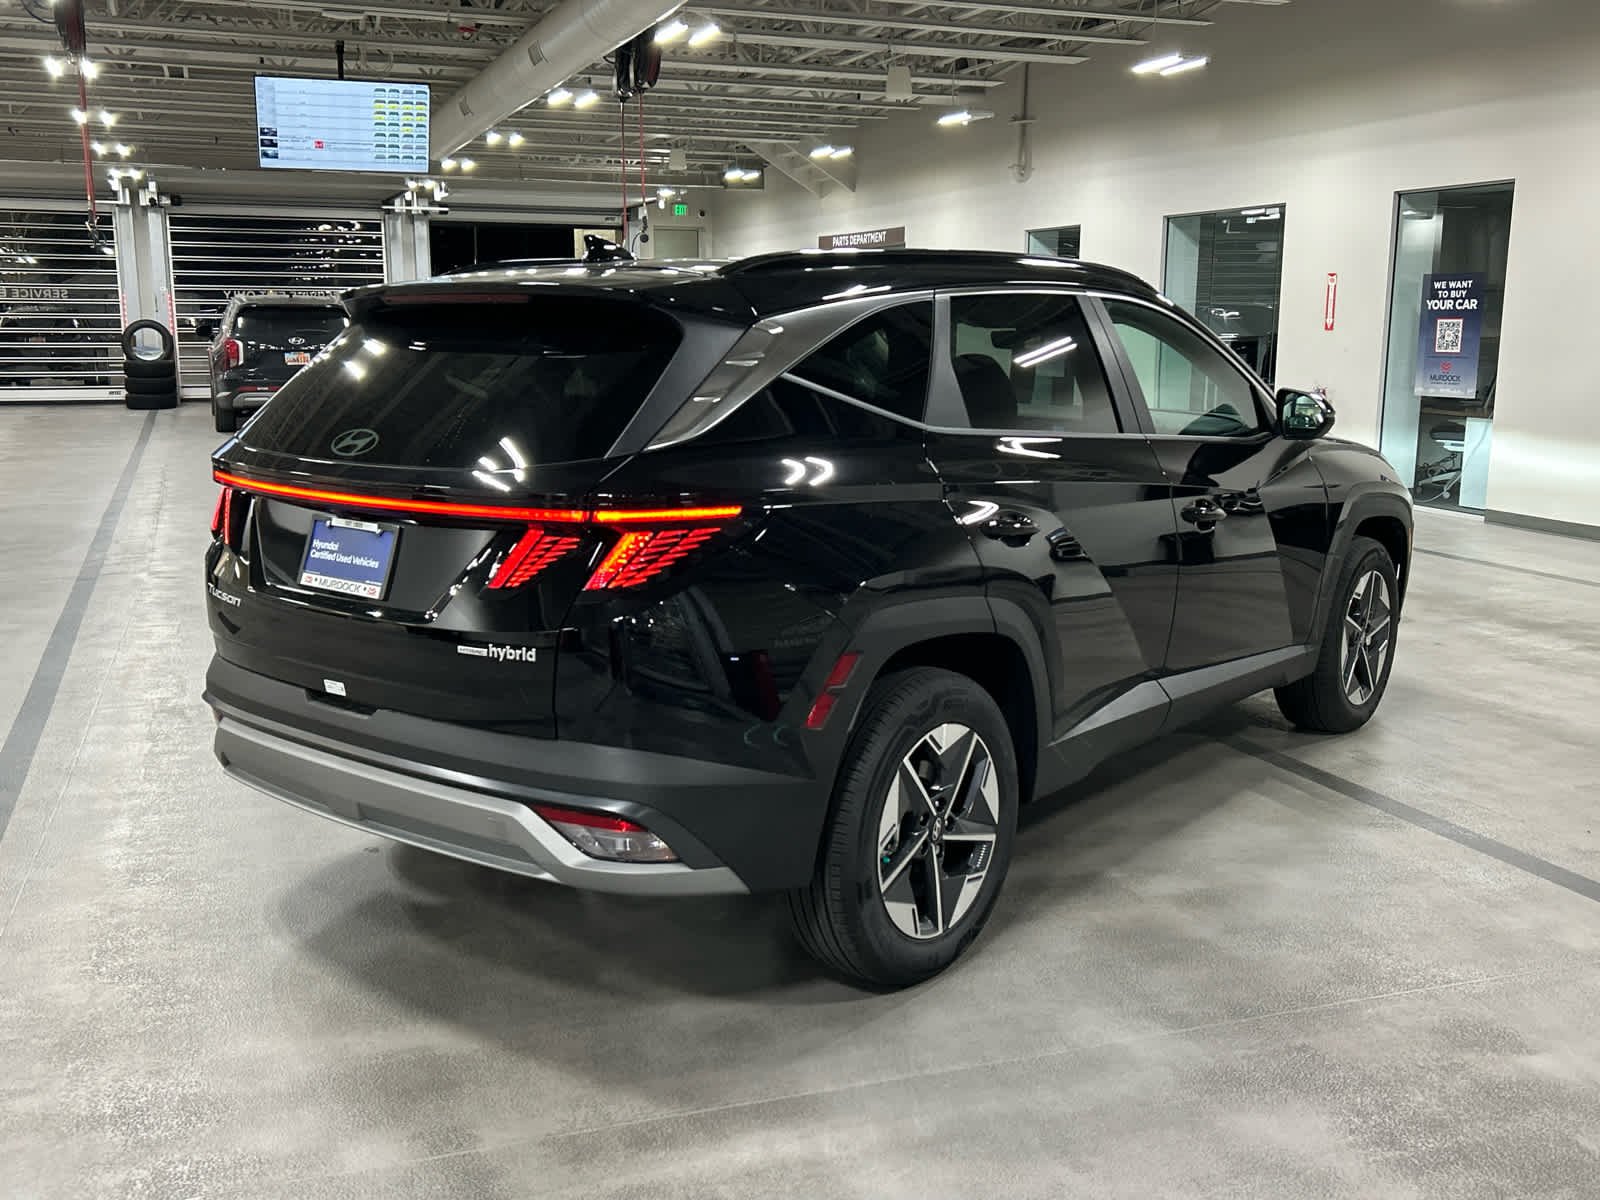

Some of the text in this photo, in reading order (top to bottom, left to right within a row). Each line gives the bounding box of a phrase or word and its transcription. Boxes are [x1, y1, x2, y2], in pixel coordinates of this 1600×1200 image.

[832, 231, 887, 247] PARTS DEPARTMENT
[1433, 280, 1473, 289] WE WANT
[1437, 289, 1468, 298] TO BUY
[1426, 299, 1478, 310] YOUR CAR
[312, 539, 340, 551] Hyundai
[310, 549, 380, 569] Certified Used Vehicles
[319, 577, 362, 594] MURDOCK
[488, 643, 537, 662] hybrid
